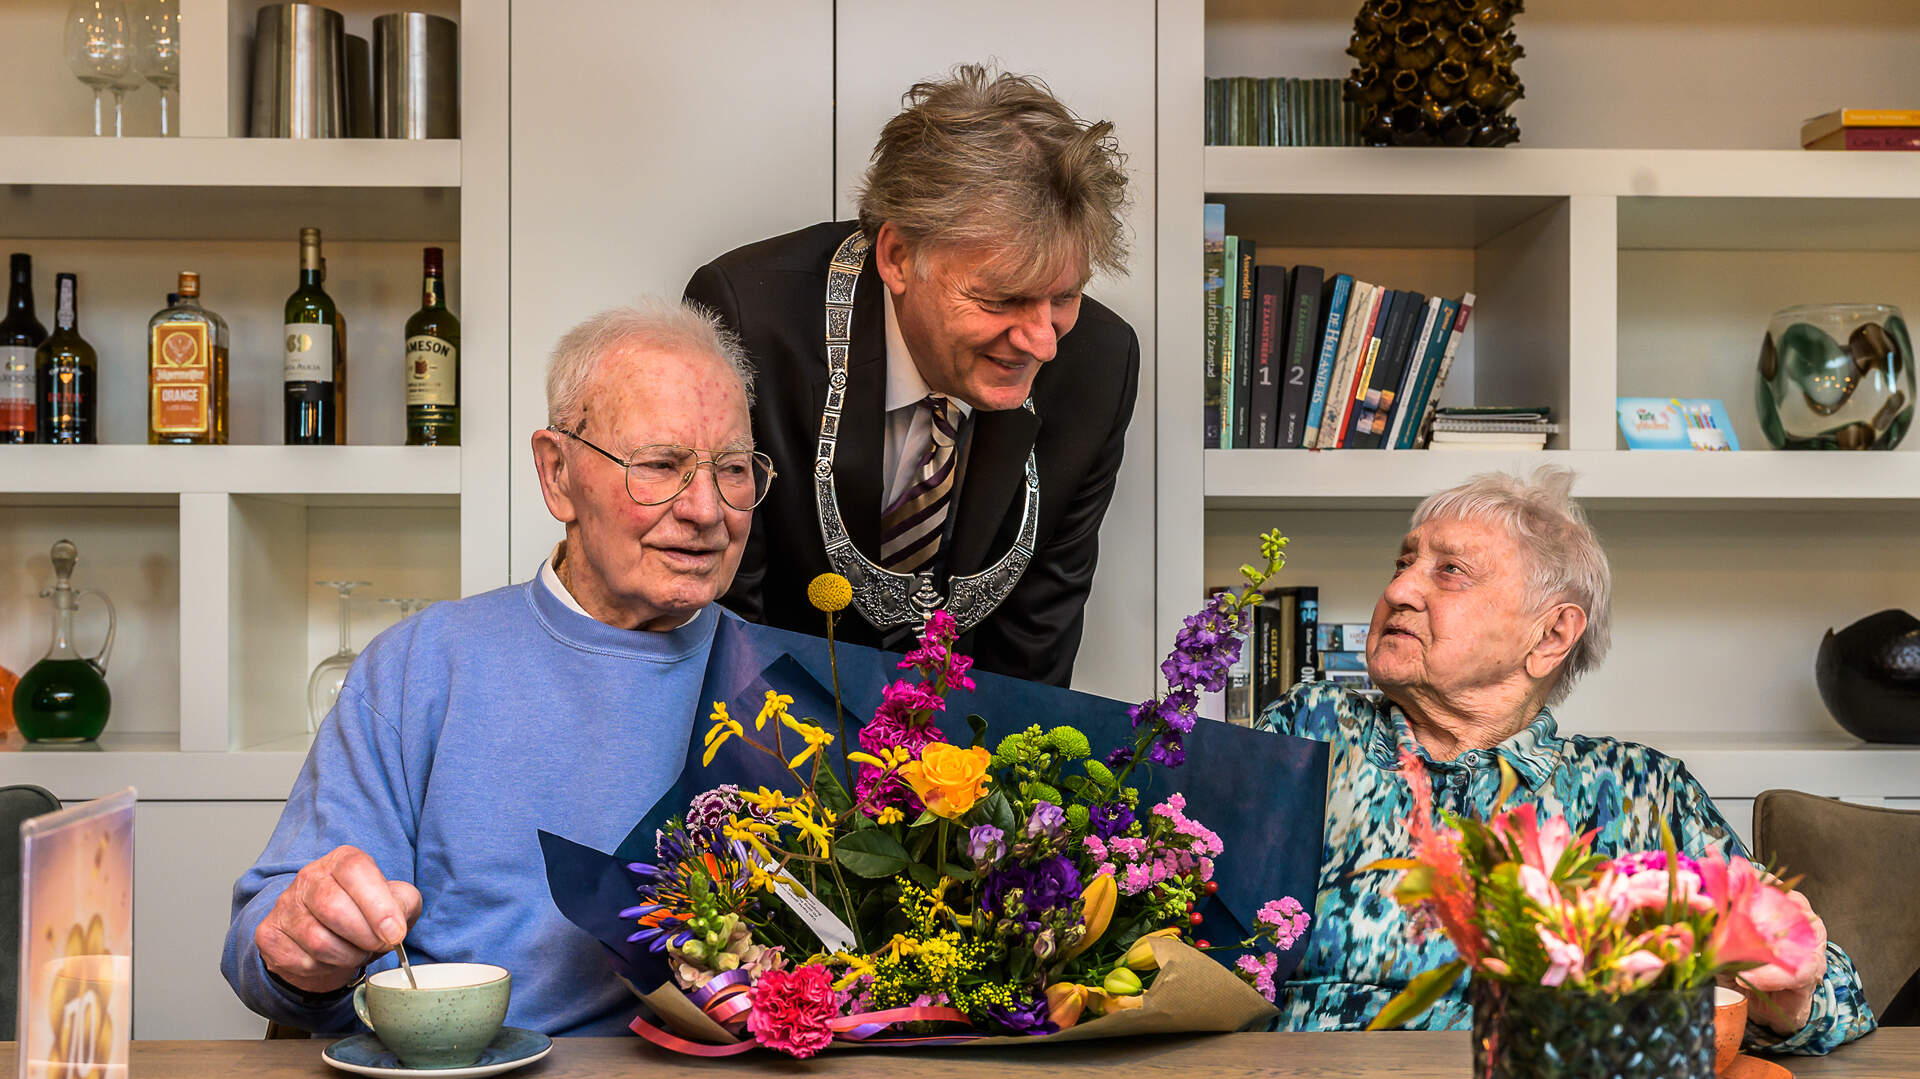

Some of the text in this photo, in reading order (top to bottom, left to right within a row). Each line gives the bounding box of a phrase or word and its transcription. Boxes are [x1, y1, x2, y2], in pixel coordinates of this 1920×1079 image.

[1207, 268, 1220, 378] Natuuratlas Zaanstad
[1328, 312, 1341, 328] DE
[407, 340, 450, 357] AMESON
[1259, 366, 1272, 386] 1
[1289, 366, 1305, 386] 2
[1311, 328, 1341, 404] HOLLANDERS
[161, 389, 199, 402] ORANGE
